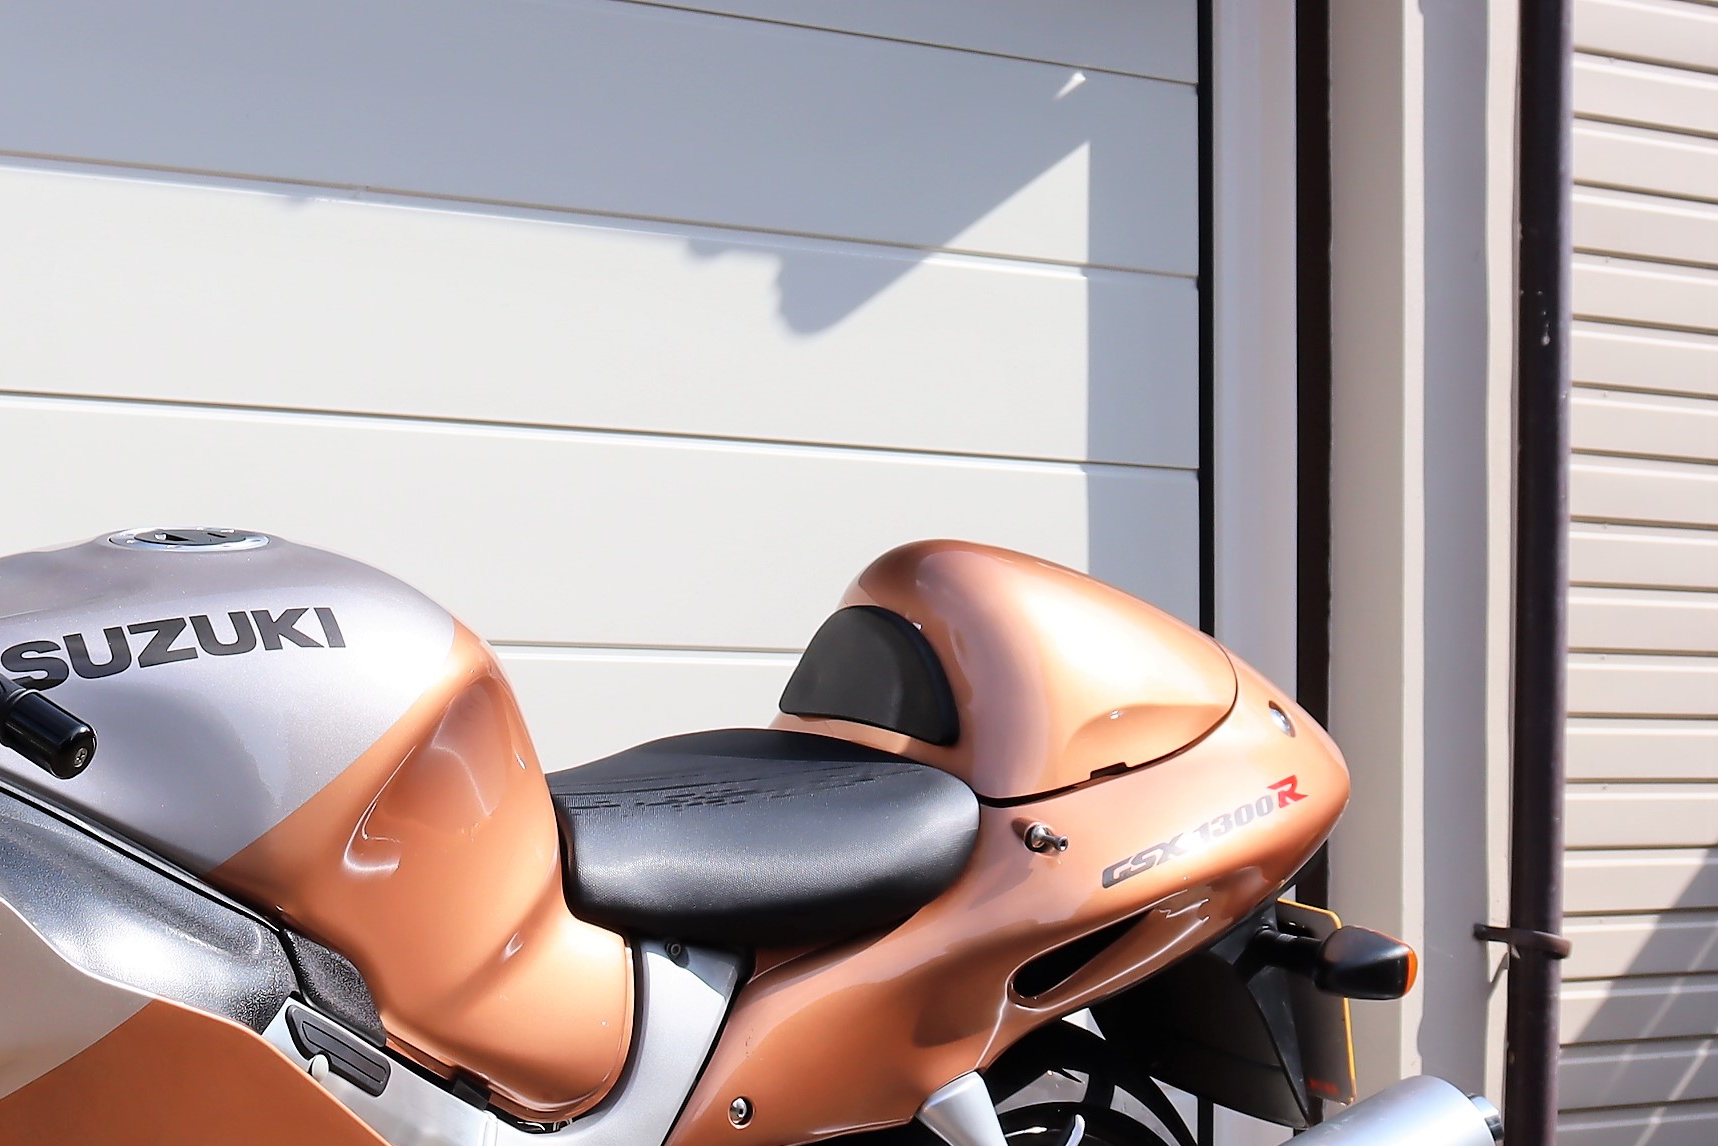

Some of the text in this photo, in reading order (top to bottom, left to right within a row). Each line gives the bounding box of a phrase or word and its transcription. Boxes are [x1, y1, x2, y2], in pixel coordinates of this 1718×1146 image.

[0, 607, 346, 691] SUZUKI
[1101, 774, 1308, 889] GSX 1300R
